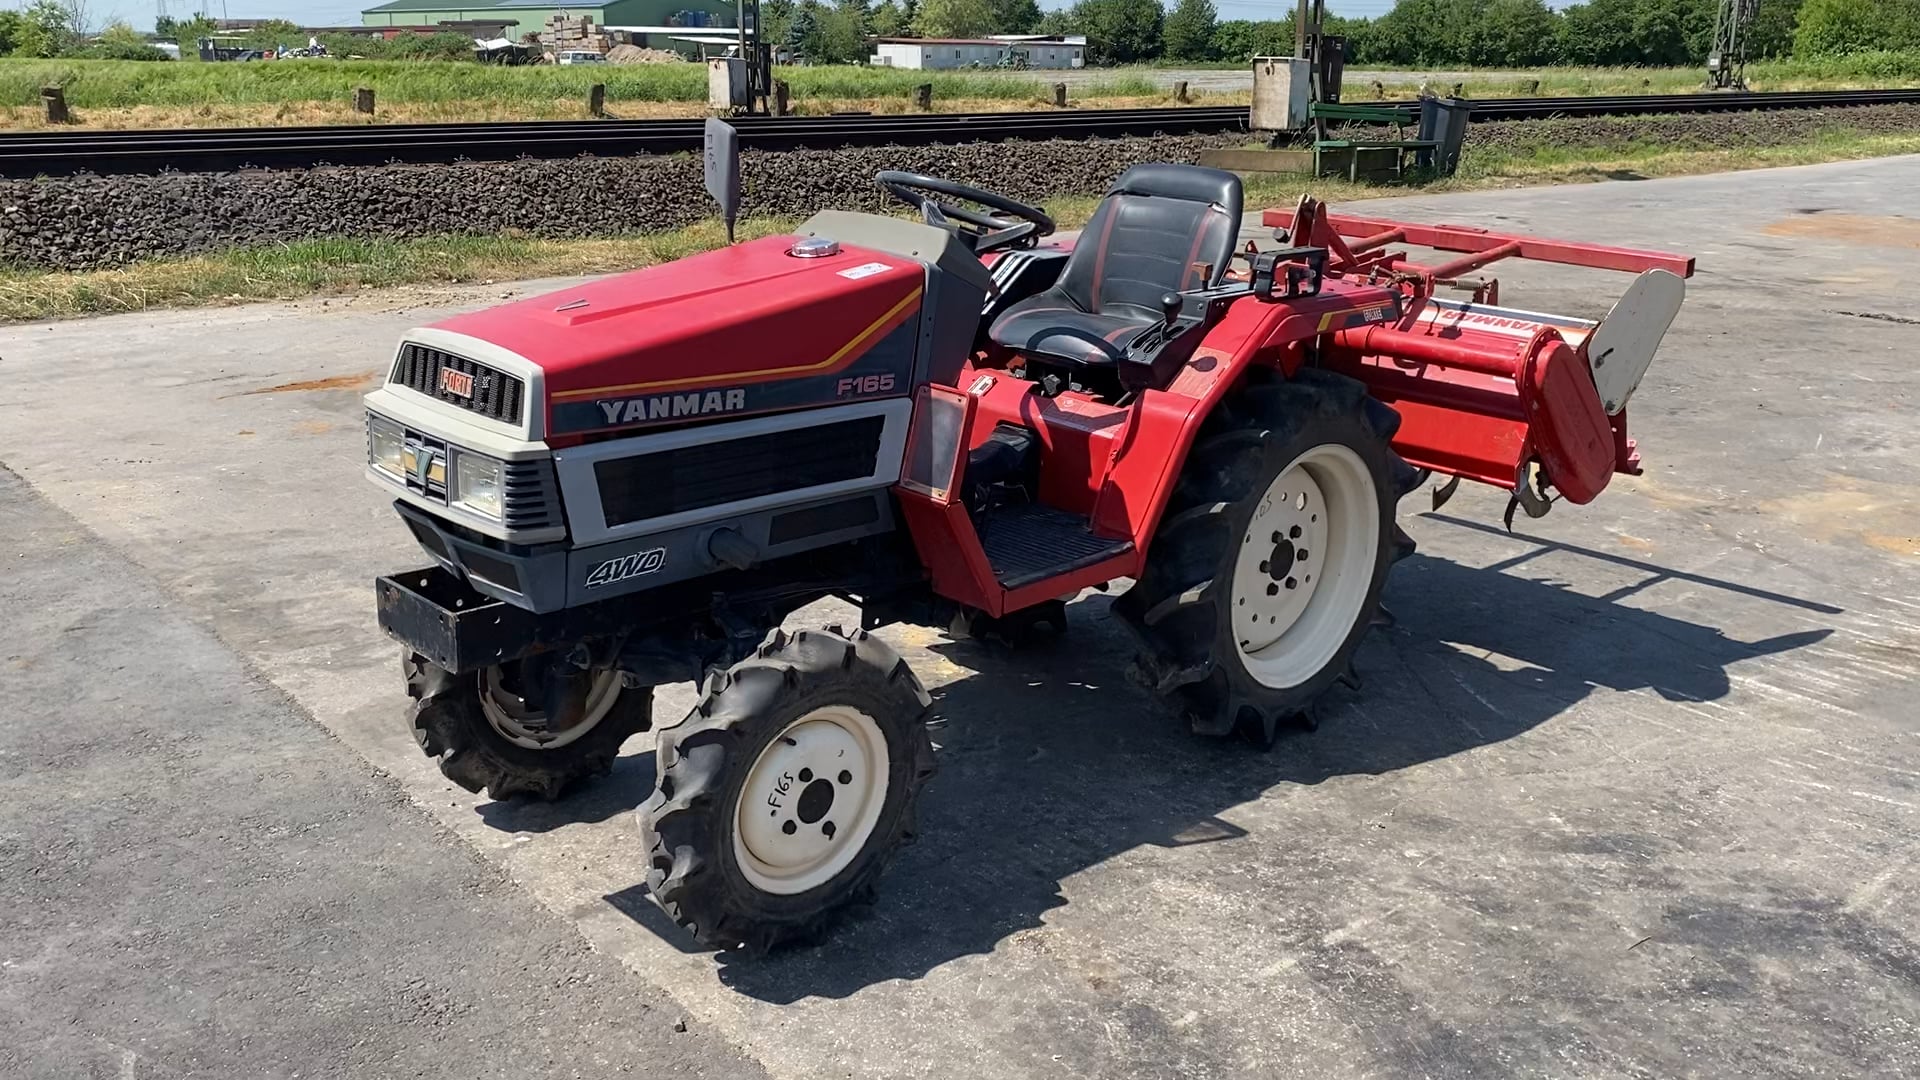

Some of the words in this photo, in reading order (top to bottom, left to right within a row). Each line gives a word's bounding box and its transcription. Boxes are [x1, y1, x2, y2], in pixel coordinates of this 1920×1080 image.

[837, 373, 895, 396] F165
[600, 388, 746, 424] YANMAR
[586, 547, 665, 586] 4WD
[767, 771, 794, 808] F165
